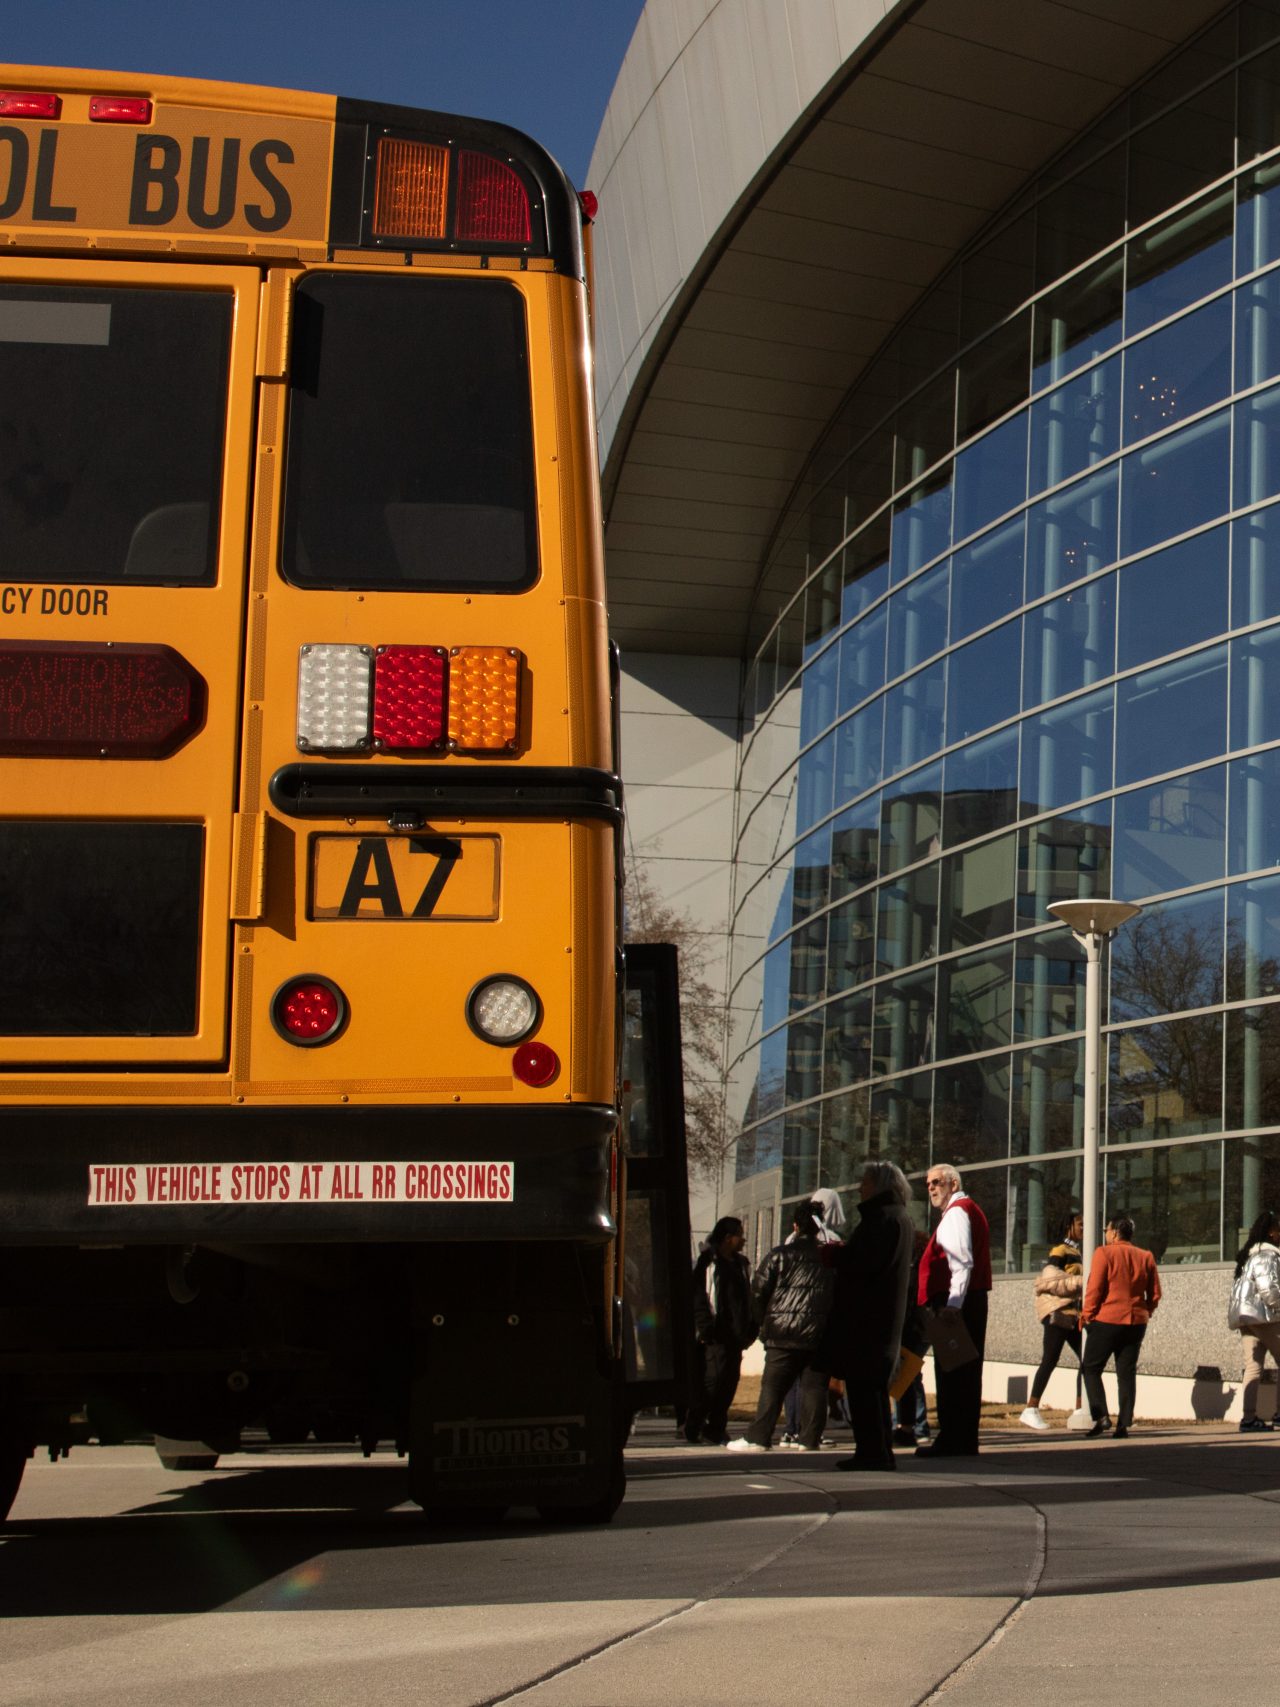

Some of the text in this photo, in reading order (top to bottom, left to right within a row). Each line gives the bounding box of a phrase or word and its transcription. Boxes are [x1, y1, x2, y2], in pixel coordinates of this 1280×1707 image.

[128, 133, 295, 232] BUS
[1, 586, 109, 616] CY DOOR
[337, 837, 463, 918] A7
[93, 1164, 511, 1203] THIS VEHICLE STOPS AT ALL RR CROSSINGS
[443, 1416, 573, 1457] Thomas
